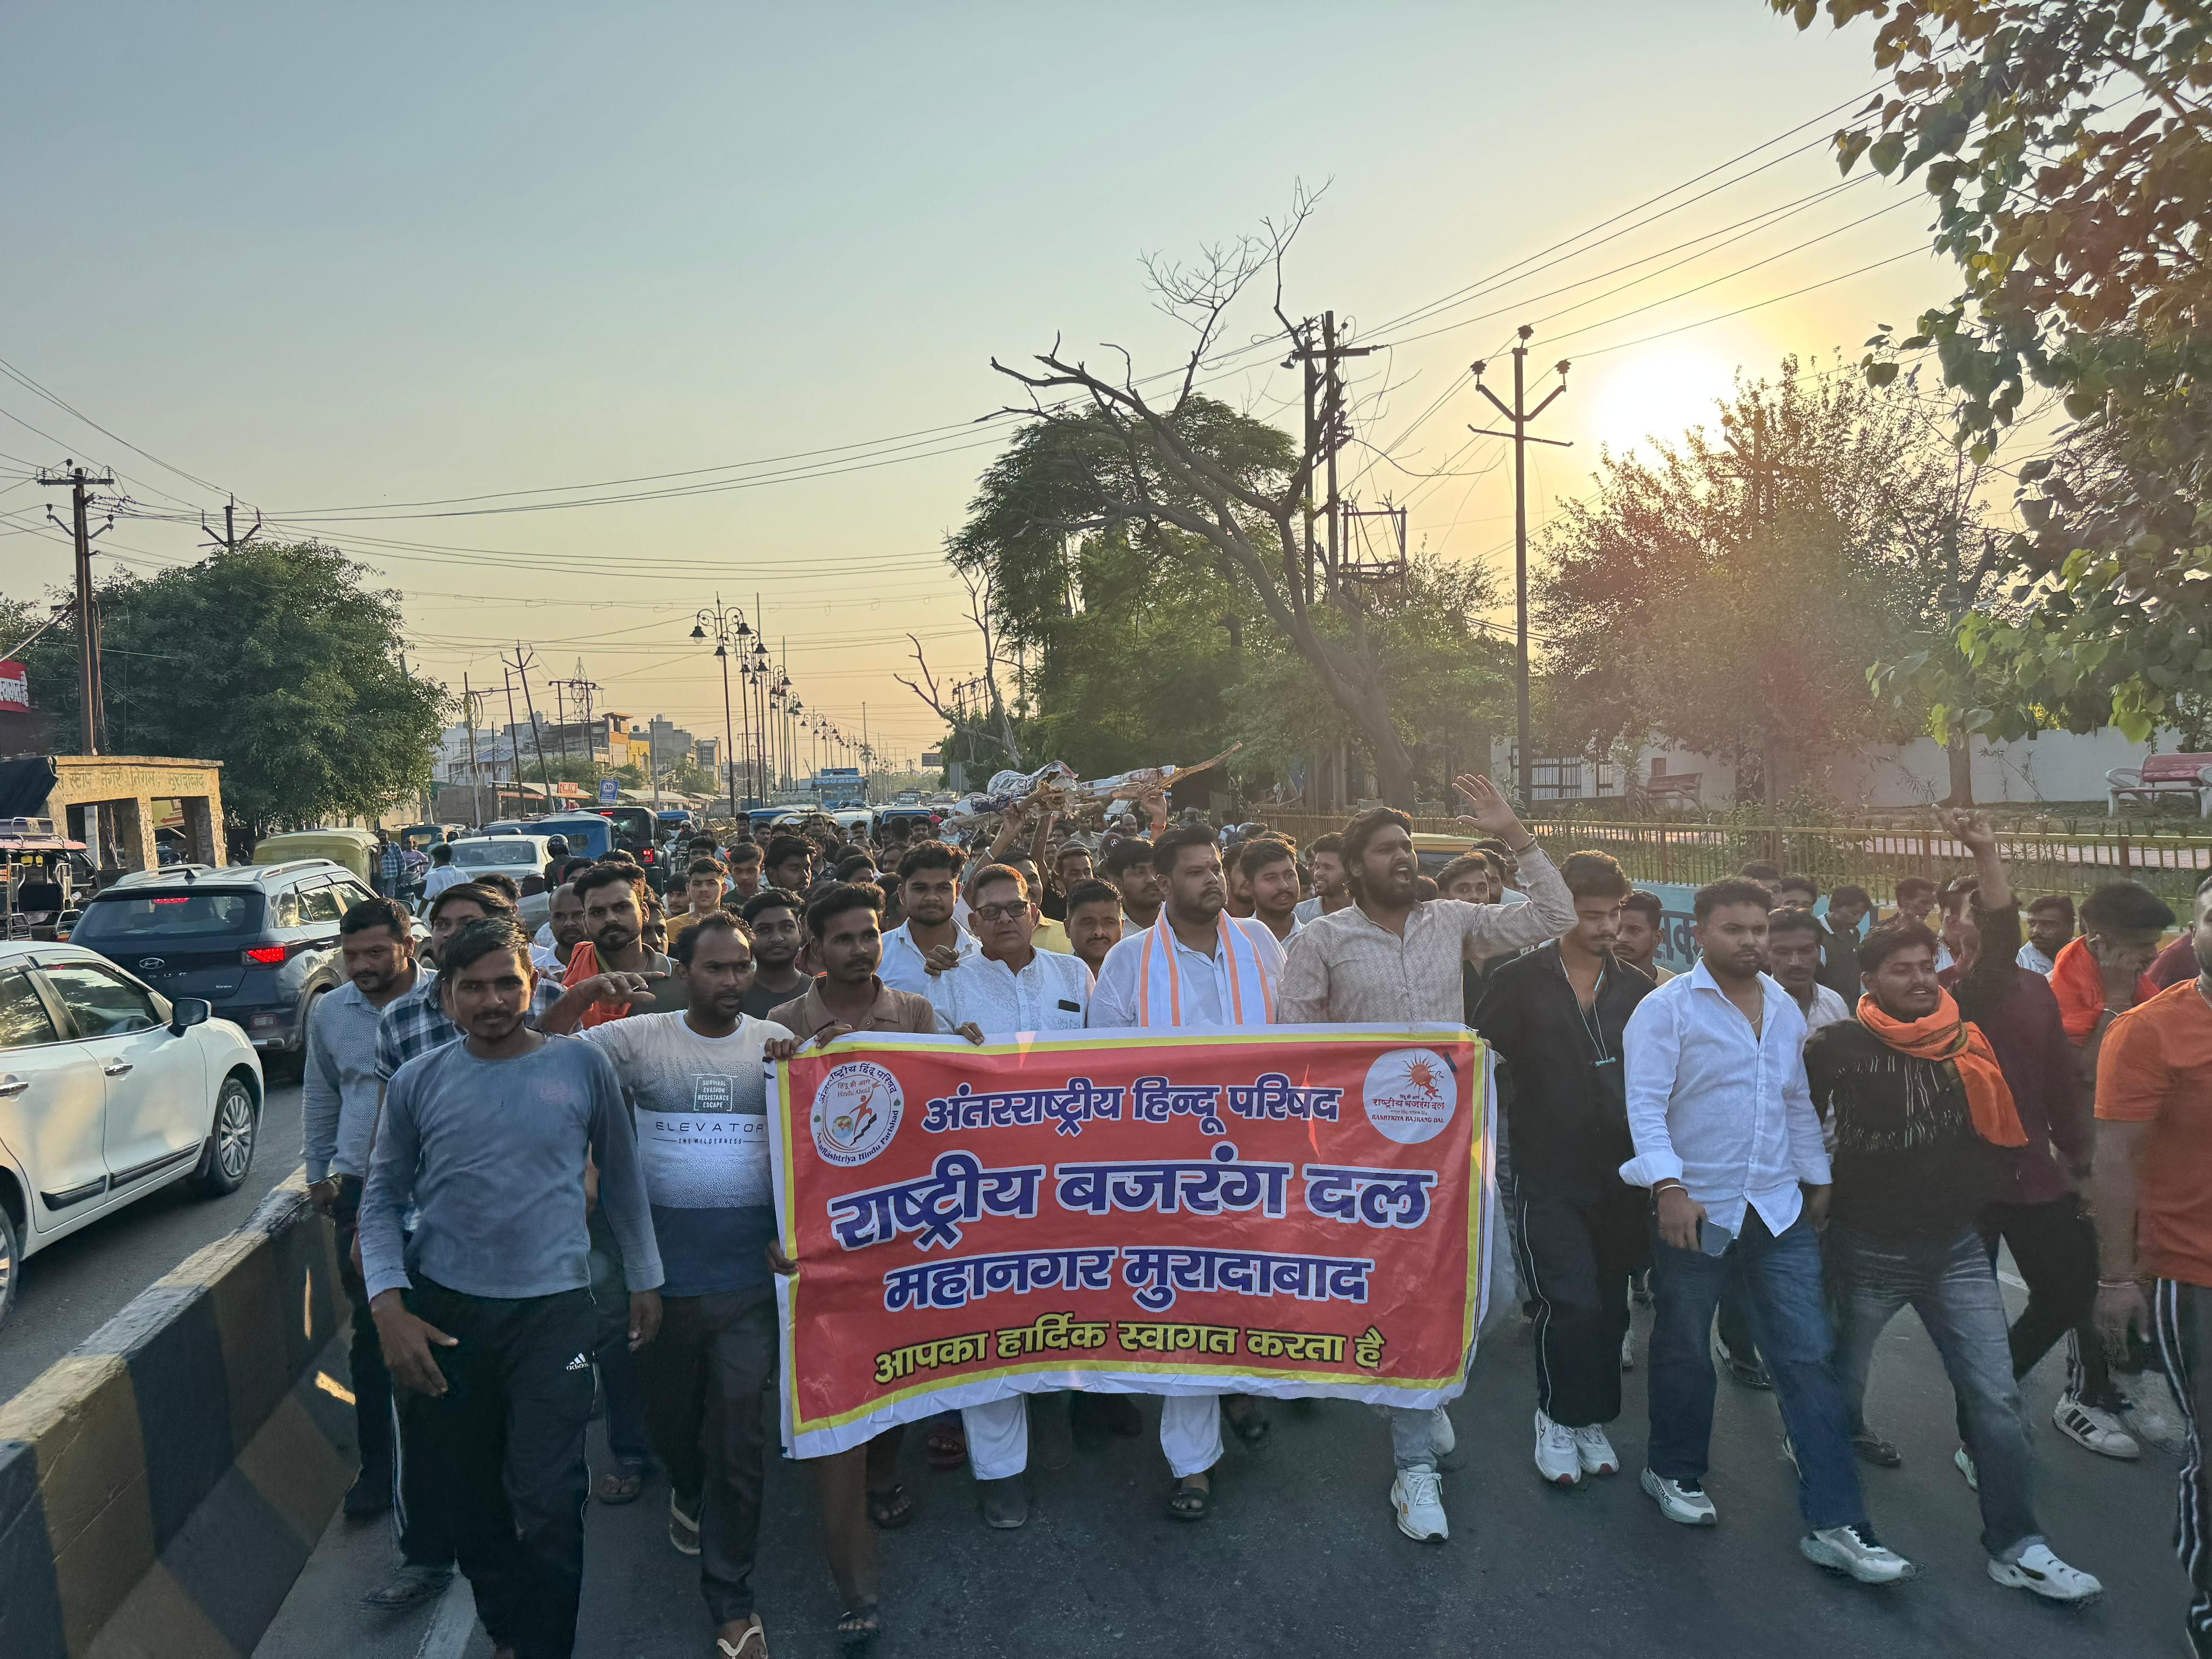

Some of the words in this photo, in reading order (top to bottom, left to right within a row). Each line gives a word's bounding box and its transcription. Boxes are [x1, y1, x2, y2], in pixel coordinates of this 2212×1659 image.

[877, 1069, 897, 1094] परिषद
[921, 1077, 1124, 1136] अंतरराष्ट्रीय
[1133, 1076, 1226, 1136] हिन्दू
[1228, 1073, 1344, 1121] परिषद
[1373, 1097, 1402, 1109] राष्ट्रीय
[1432, 1101, 1444, 1111] दल
[656, 1121, 764, 1133] ELEVATOR
[859, 1144, 881, 1161] Hindu
[880, 1110, 899, 1145] Parishad
[827, 1149, 1045, 1251] राष्ट्रीय
[1056, 1141, 1290, 1216] बजरंग
[1302, 1164, 1438, 1228] दल
[883, 1246, 1118, 1312] महानगर
[1119, 1245, 1375, 1312] मुरादाबाद
[874, 1332, 988, 1385] आपका
[997, 1312, 1111, 1359] हार्दिक
[1117, 1320, 1238, 1356] स्वागत
[1247, 1327, 1348, 1363] करता
[1354, 1325, 1386, 1370] है
